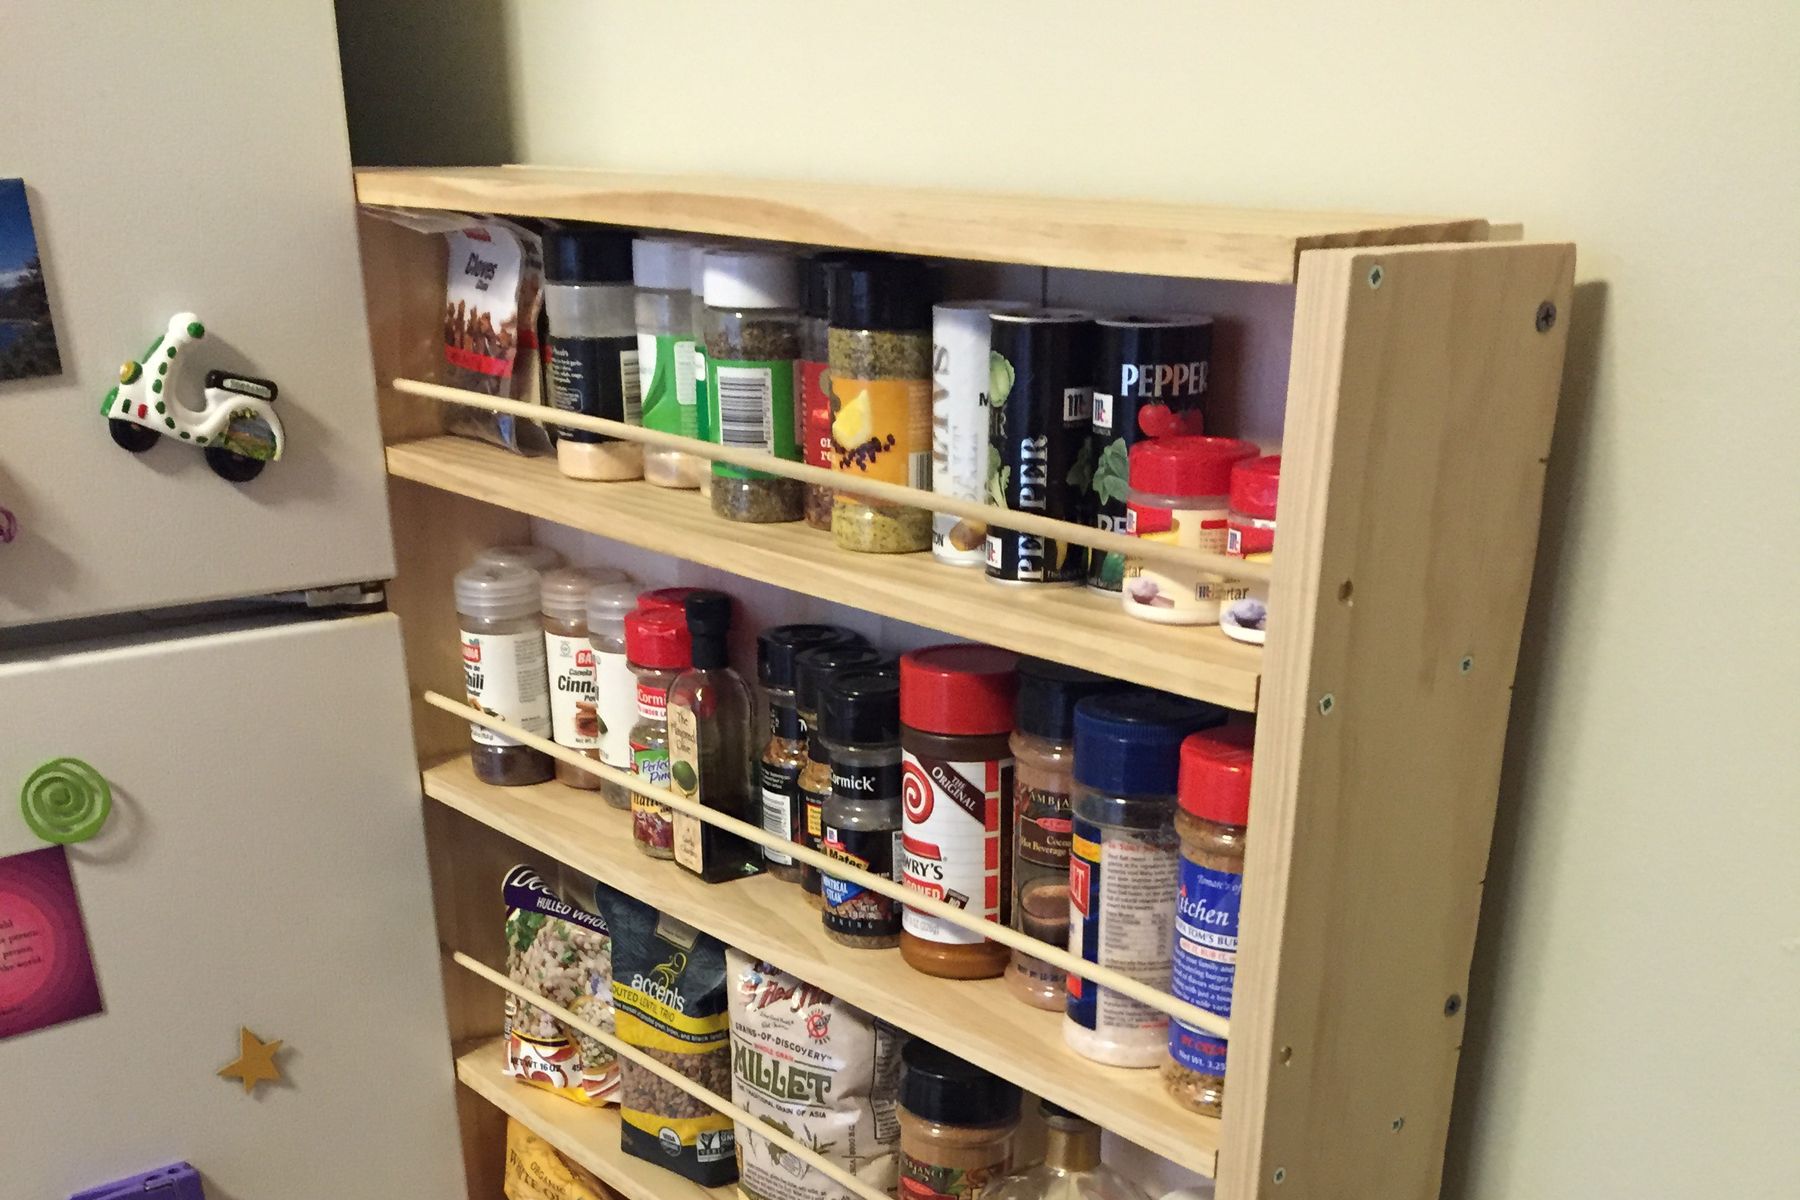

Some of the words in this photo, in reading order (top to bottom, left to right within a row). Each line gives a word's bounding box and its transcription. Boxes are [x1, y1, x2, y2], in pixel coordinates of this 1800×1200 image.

[465, 251, 498, 281] Cloves
[638, 688, 667, 707] Cormi
[642, 760, 669, 774] Perfec
[951, 776, 966, 789] THE
[537, 897, 572, 915] HULLED
[1177, 898, 1229, 927] itchen
[1188, 929, 1214, 943] TOM'S
[631, 973, 686, 1014] accents
[659, 1007, 675, 1023] TRIO
[734, 1039, 832, 1105] MILLET
[809, 1110, 827, 1119] ASIA
